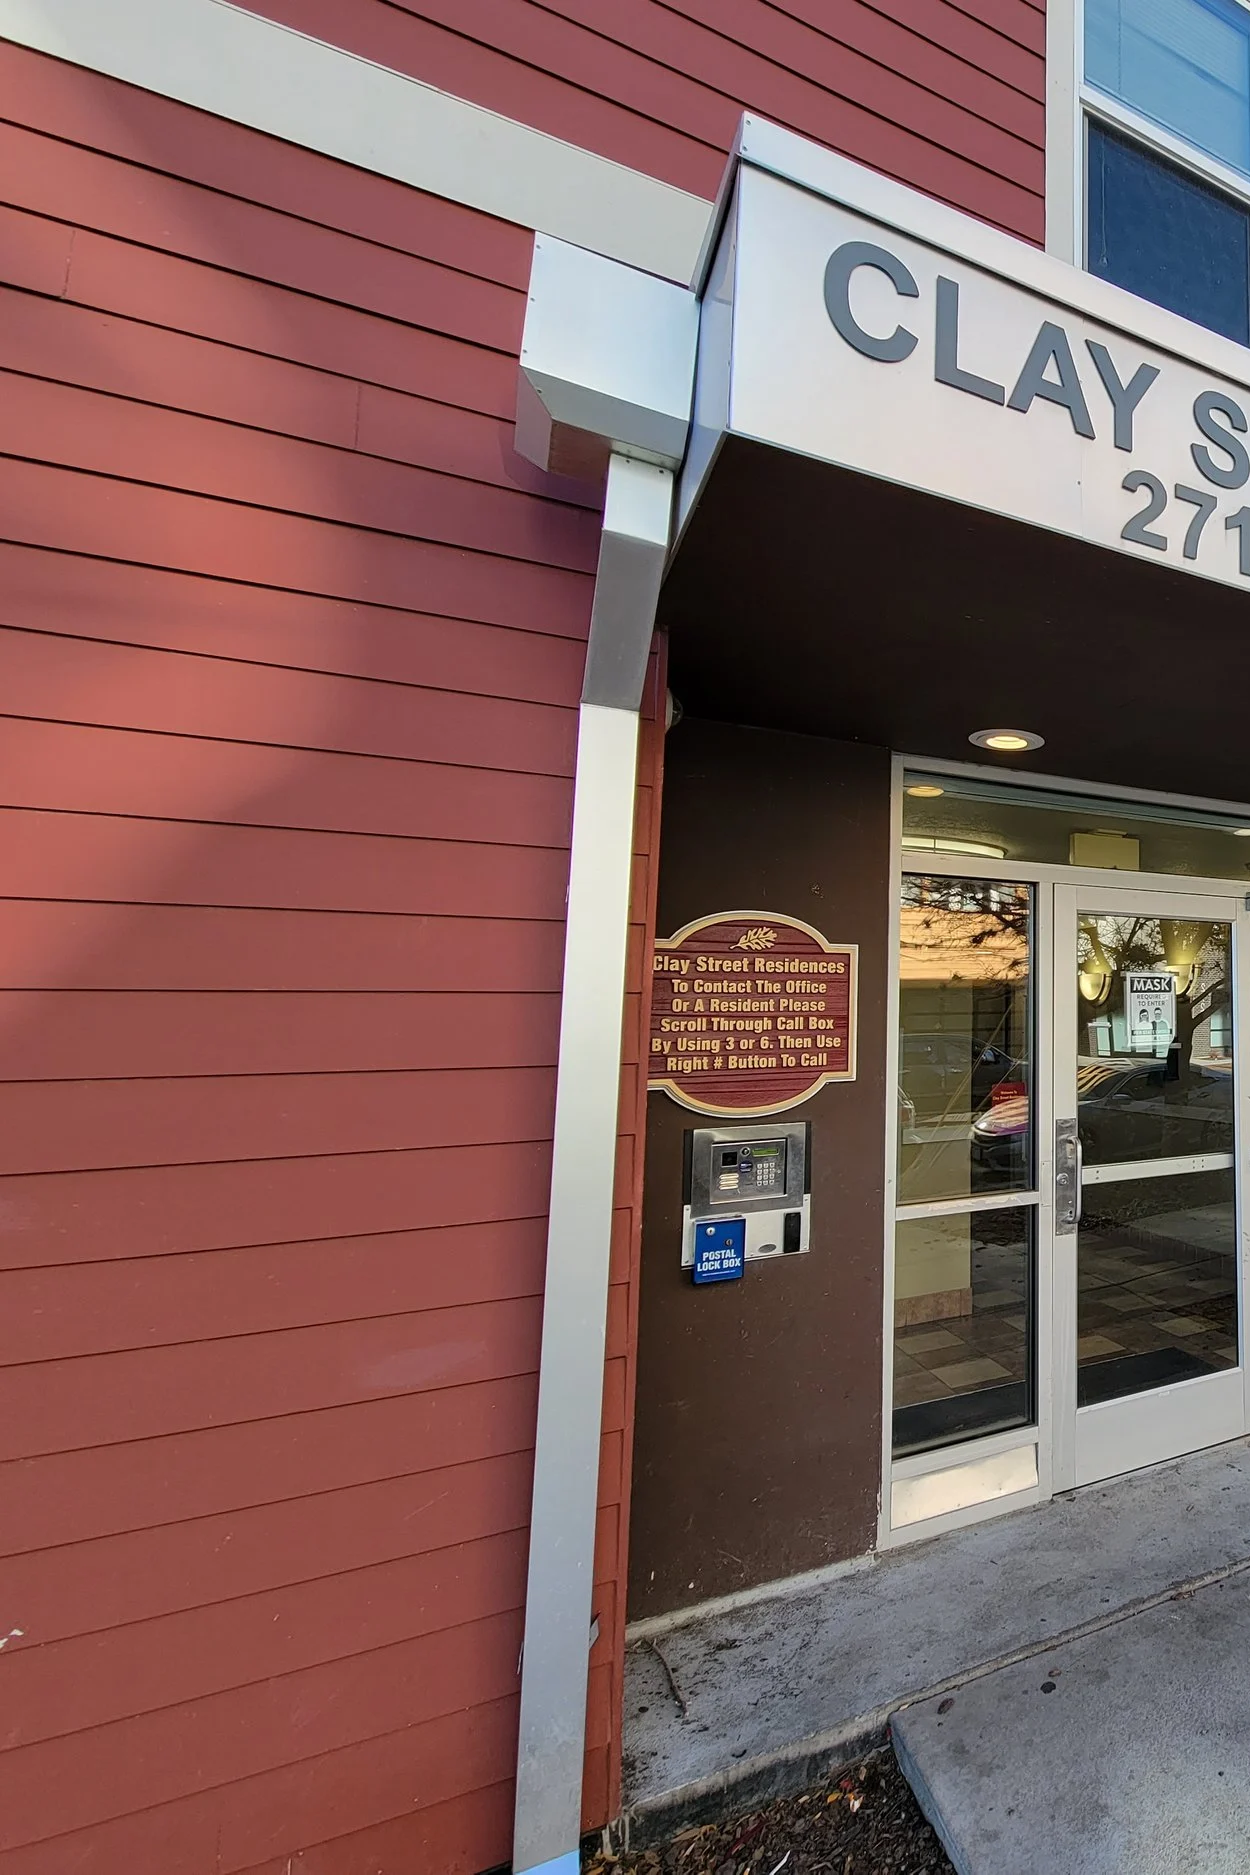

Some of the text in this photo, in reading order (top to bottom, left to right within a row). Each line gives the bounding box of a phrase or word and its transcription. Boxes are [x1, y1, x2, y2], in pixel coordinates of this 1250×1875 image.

[823, 240, 1160, 453] CLAY
[653, 955, 845, 974] Clay Street Residences
[672, 979, 827, 993] To Contact The Office
[1132, 978, 1170, 991] MASK
[672, 998, 826, 1012] Or A Resident Please
[660, 1017, 834, 1034] Scroll Through Call Box
[651, 1034, 841, 1054] By Using 3 or 6. Then Use
[667, 1053, 827, 1074] Right # Button To Call
[702, 1249, 736, 1261] POSTAL
[697, 1258, 741, 1272] LOCK BOX
